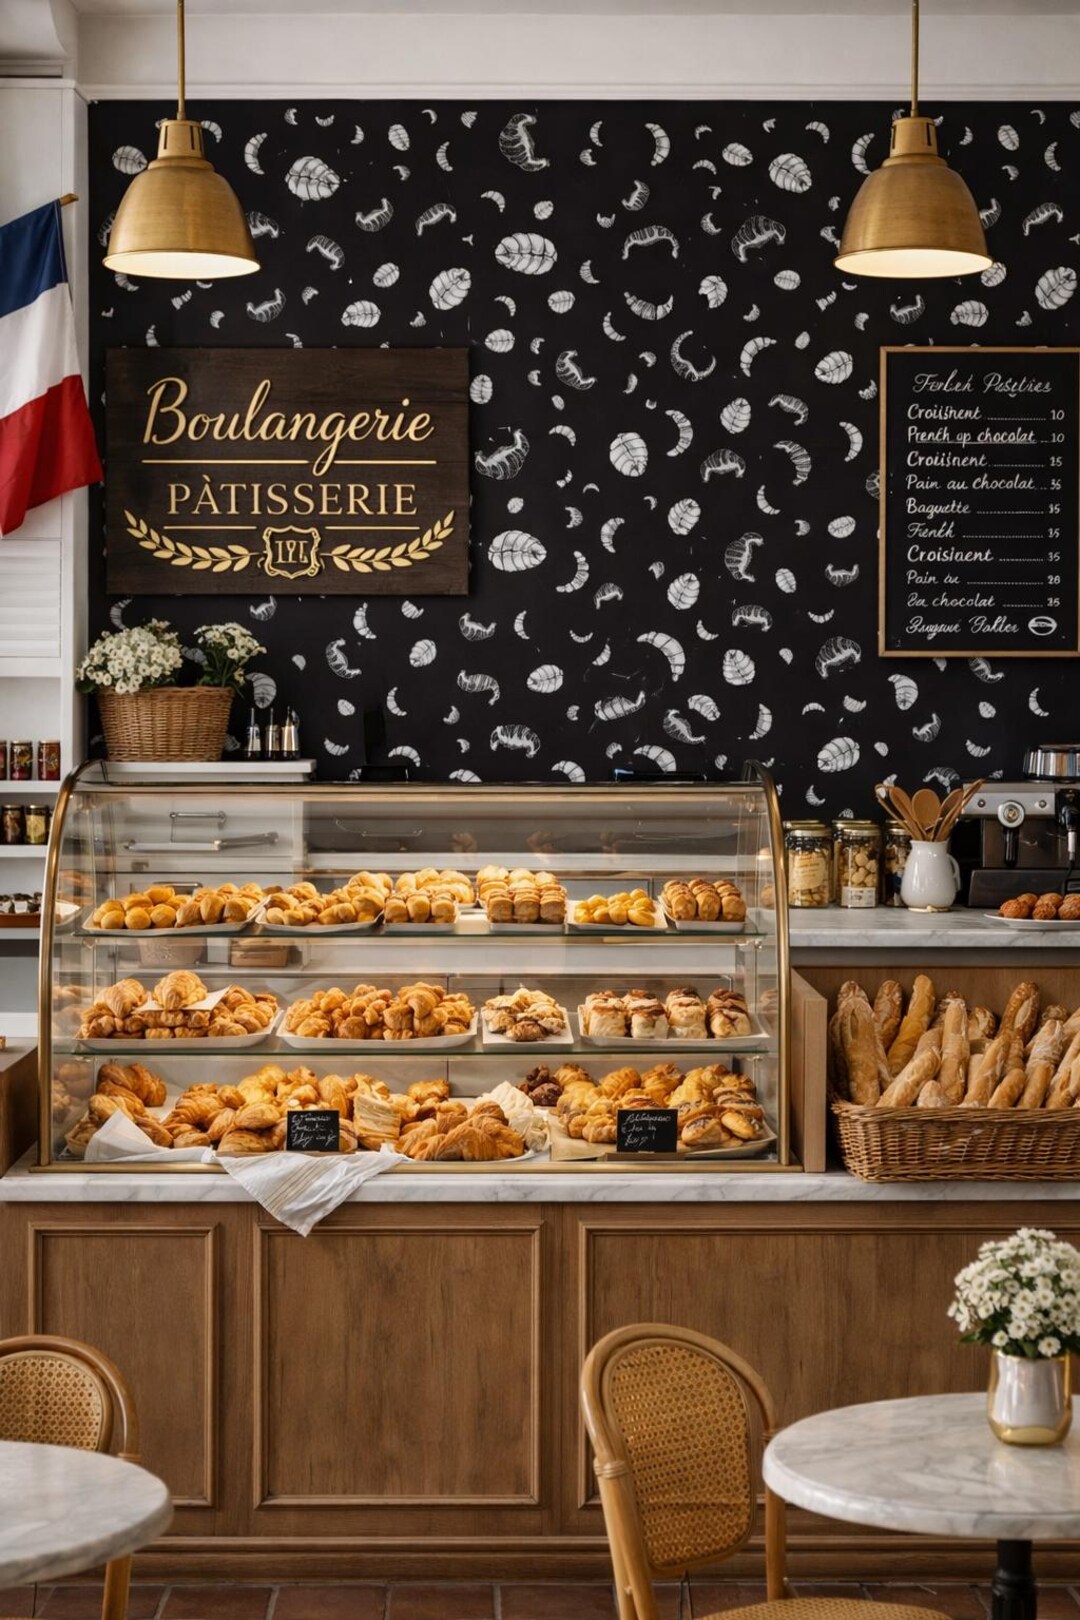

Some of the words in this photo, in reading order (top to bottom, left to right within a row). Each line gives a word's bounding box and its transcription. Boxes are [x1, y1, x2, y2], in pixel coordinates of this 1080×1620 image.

[143, 376, 434, 477] Boulangerie
[975, 426, 1036, 444] chocolat
[905, 473, 939, 490] Pain
[946, 480, 969, 490] au
[932, 592, 995, 608] chocolat
